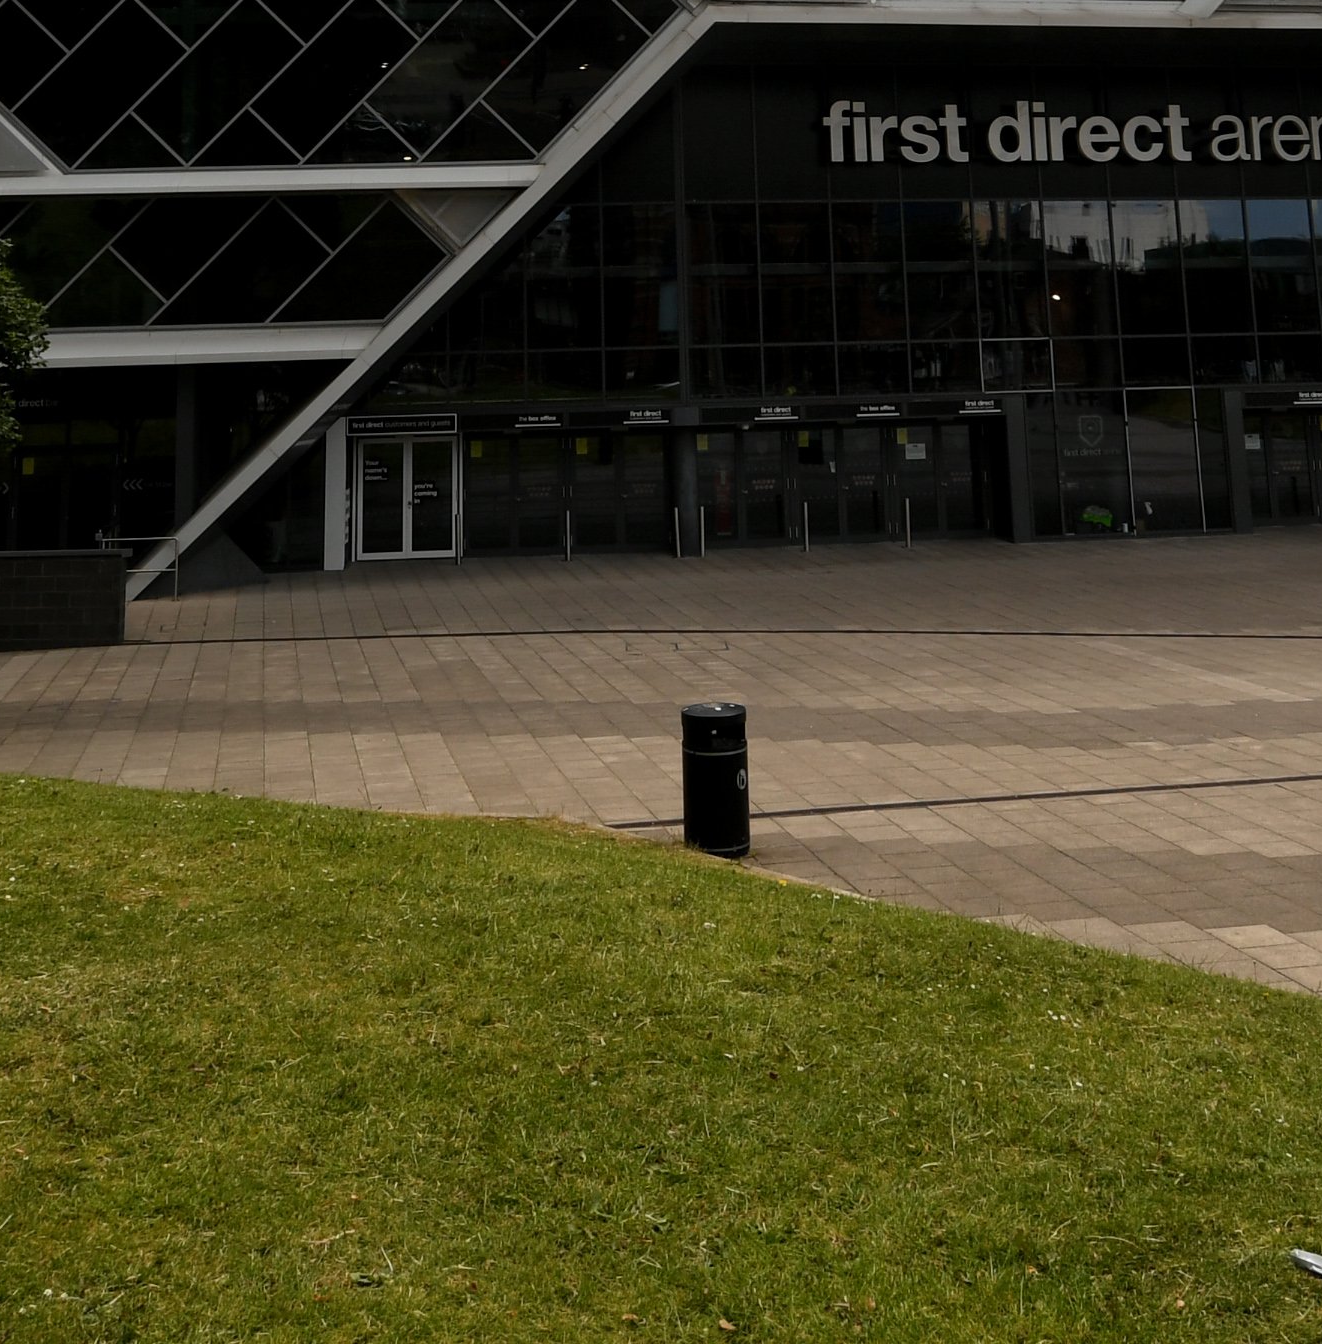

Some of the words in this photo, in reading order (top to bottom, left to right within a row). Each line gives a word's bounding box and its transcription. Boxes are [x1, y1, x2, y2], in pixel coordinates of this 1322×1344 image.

[823, 98, 969, 162] first
[987, 99, 1193, 163] direct
[352, 421, 365, 429] first
[365, 421, 384, 429] direct
